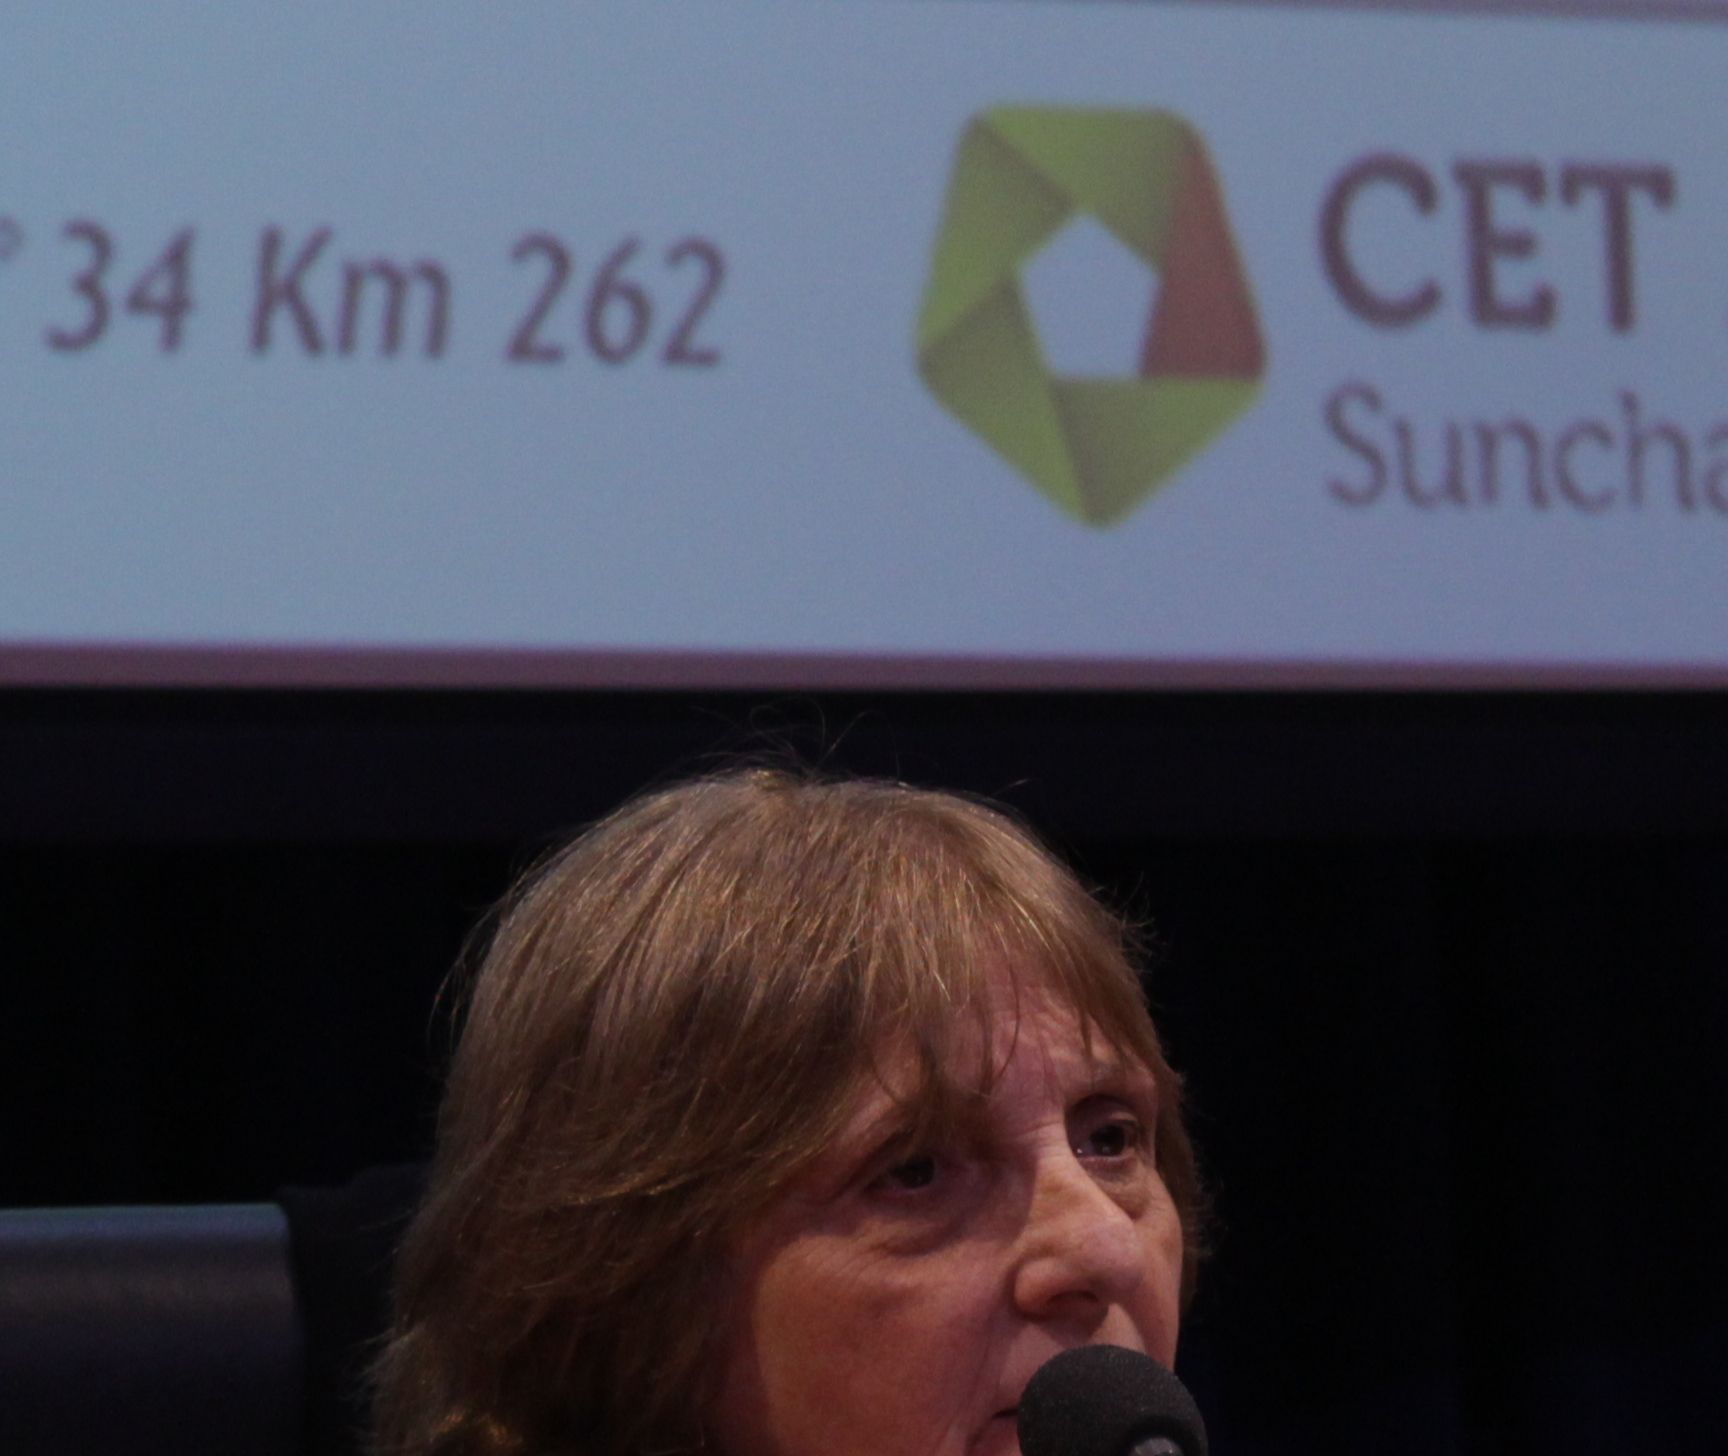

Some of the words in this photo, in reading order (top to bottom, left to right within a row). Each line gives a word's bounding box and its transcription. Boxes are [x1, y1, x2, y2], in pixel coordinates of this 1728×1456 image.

[249, 227, 452, 360] Km
[505, 233, 728, 370] 262
[1316, 153, 1677, 335] CET
